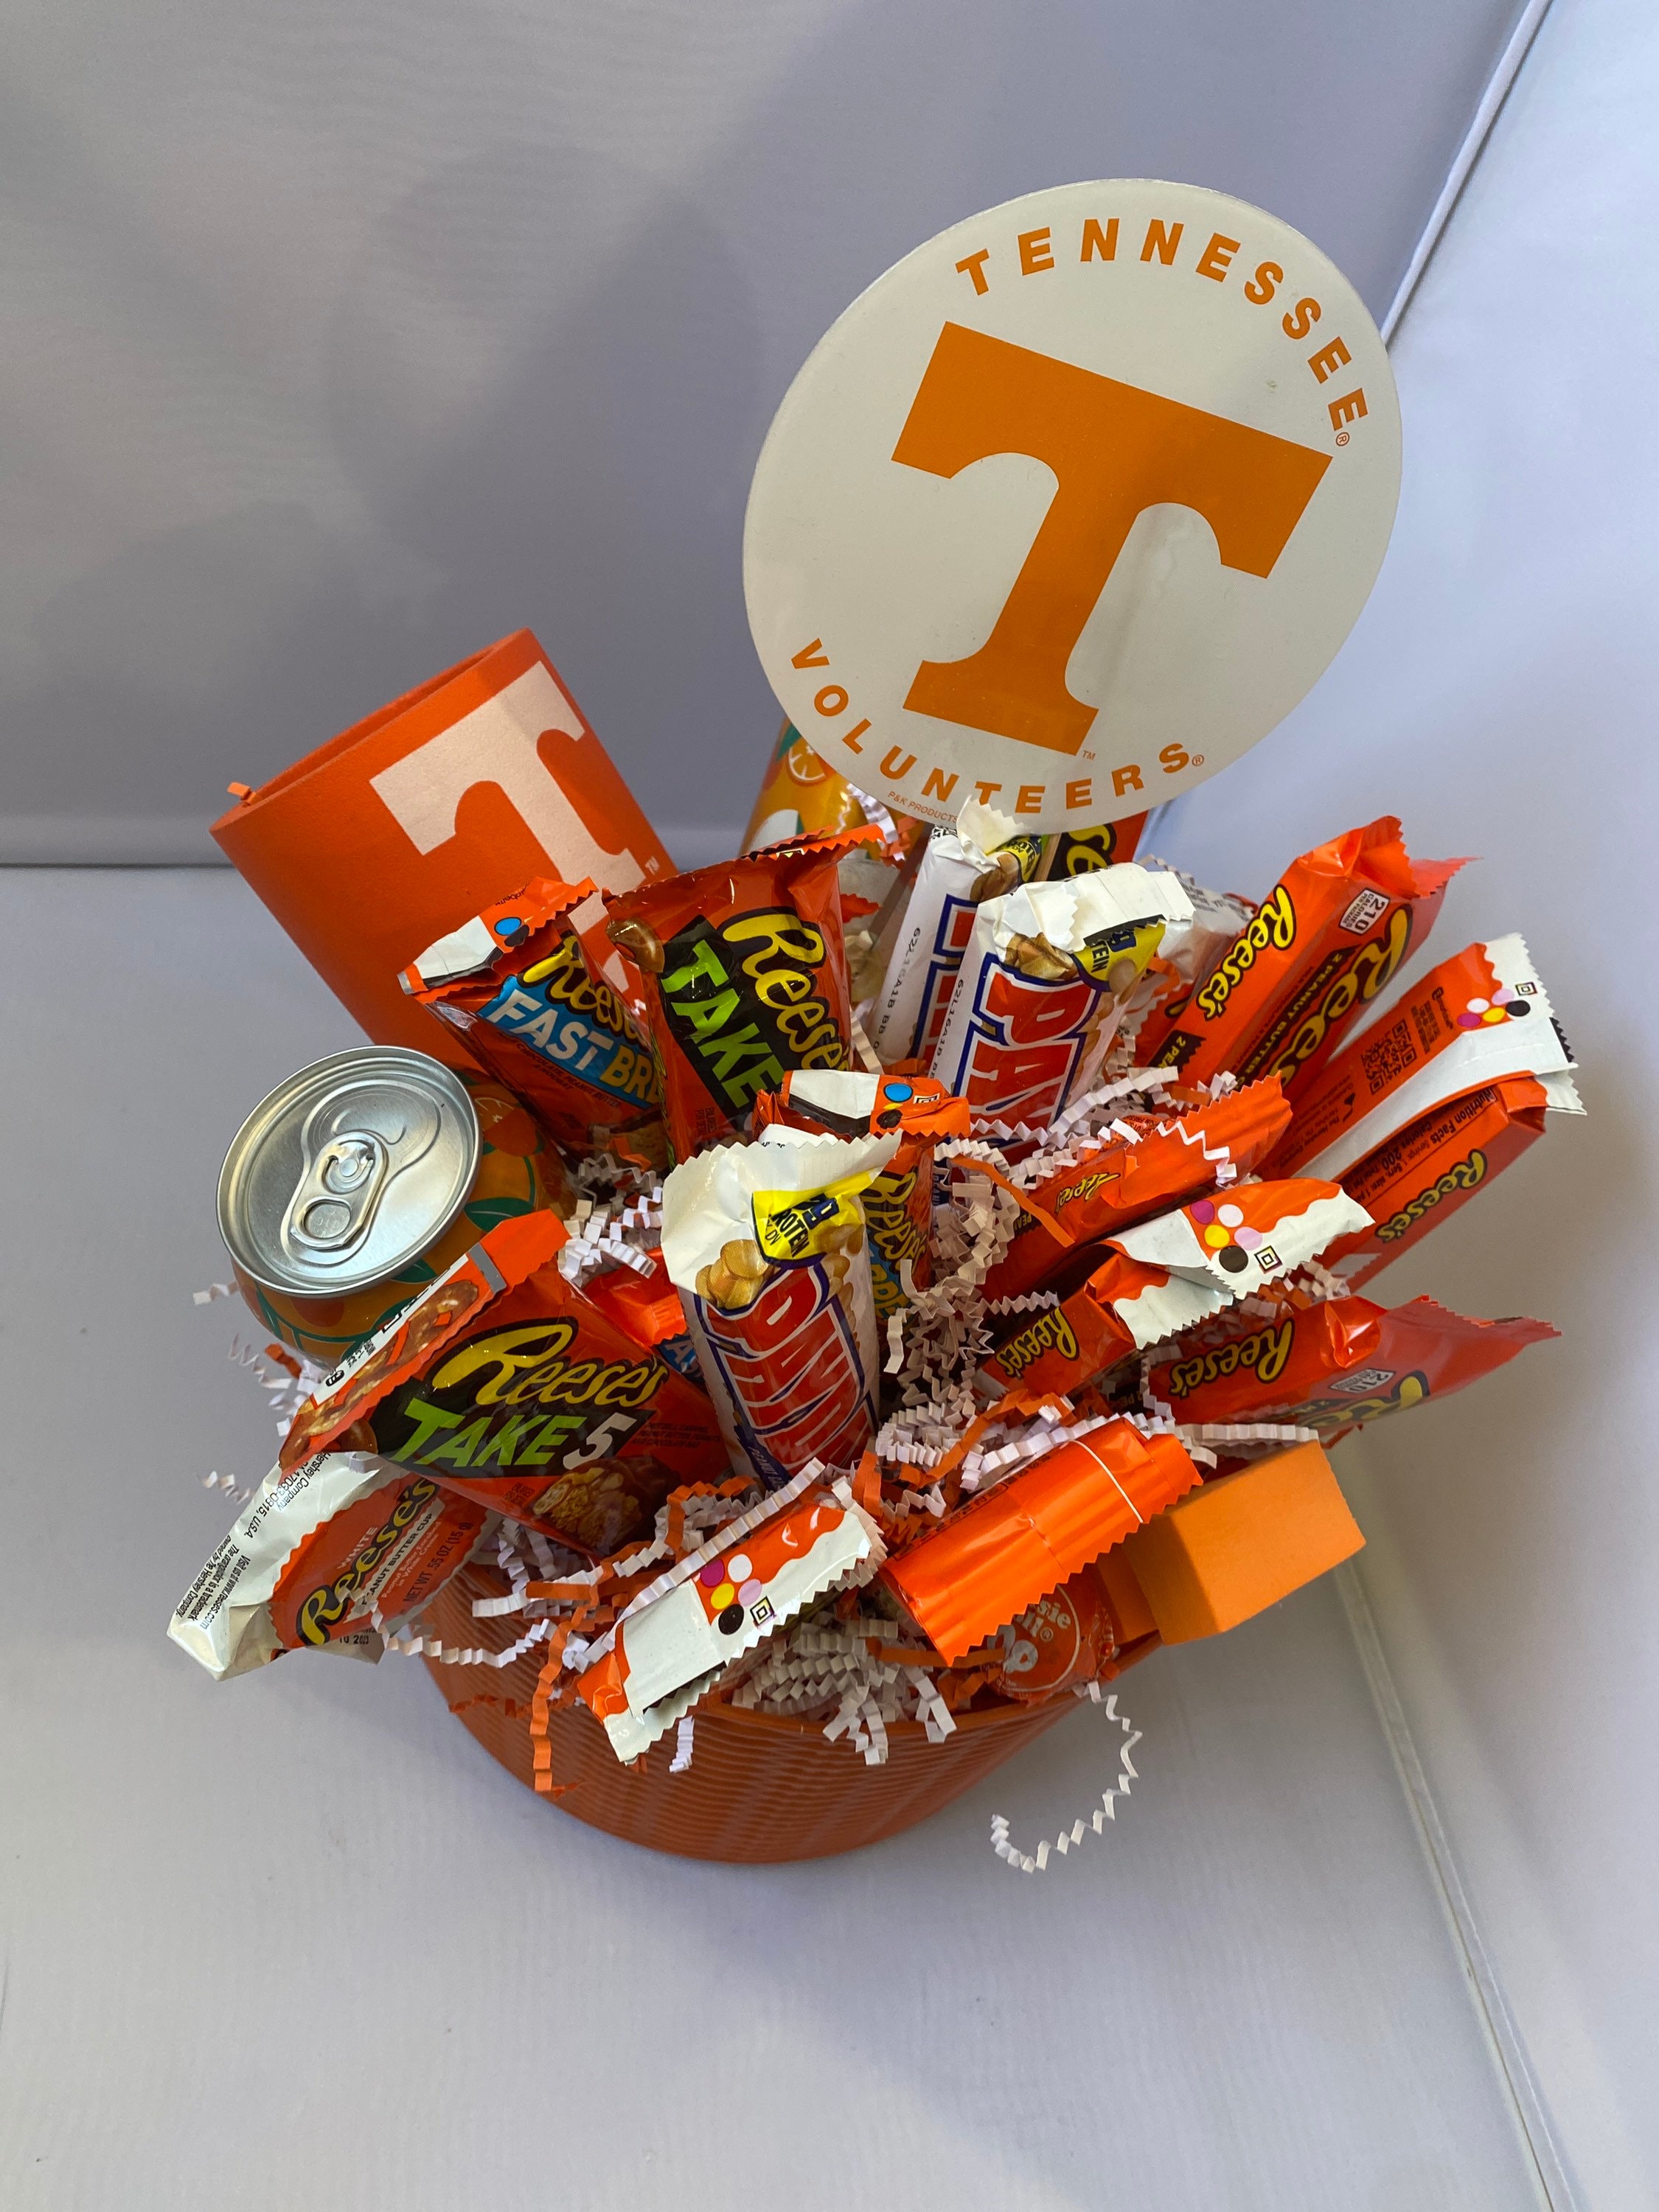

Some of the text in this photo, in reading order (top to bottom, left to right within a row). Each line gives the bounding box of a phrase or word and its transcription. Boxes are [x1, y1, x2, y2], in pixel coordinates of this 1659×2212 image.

[887, 791, 907, 805] P&K
[1346, 893, 1374, 926] CALORIES
[1354, 898, 1385, 930] 210
[1198, 886, 1293, 1018] Reese's
[1284, 962, 1335, 1019] PEANUT
[487, 989, 614, 1071] FAST
[661, 939, 785, 1108] TAKE
[1244, 1021, 1287, 1074] BUTTER
[563, 1075, 594, 1094] PEANUT
[1454, 1088, 1495, 1123] Nutrition
[1430, 1121, 1456, 1144] Facts
[1380, 1150, 1402, 1170] 200
[1378, 1151, 1485, 1241] Reese's
[772, 1209, 810, 1258] ROTEIN
[432, 1324, 667, 1406] Reese's
[997, 1307, 1077, 1377] Reese's
[1172, 1321, 1293, 1395] Reese's
[391, 1398, 637, 1469] TAKE 5
[275, 1447, 330, 1514] Hershey Company
[226, 1543, 240, 1557] The
[234, 1554, 251, 1571] Visit
[338, 1521, 377, 1574] WHITE
[388, 1529, 417, 1568] BUTTER
[416, 1511, 434, 1534] CUP
[190, 1567, 212, 1593] Hershey
[208, 1580, 218, 1590] is
[381, 1571, 402, 1599] Peanut
[403, 1555, 421, 1577] White
[403, 1583, 422, 1605] NET
[415, 1568, 433, 1587] WT
[436, 1543, 451, 1559] OZ
[187, 1590, 212, 1622] trademark
